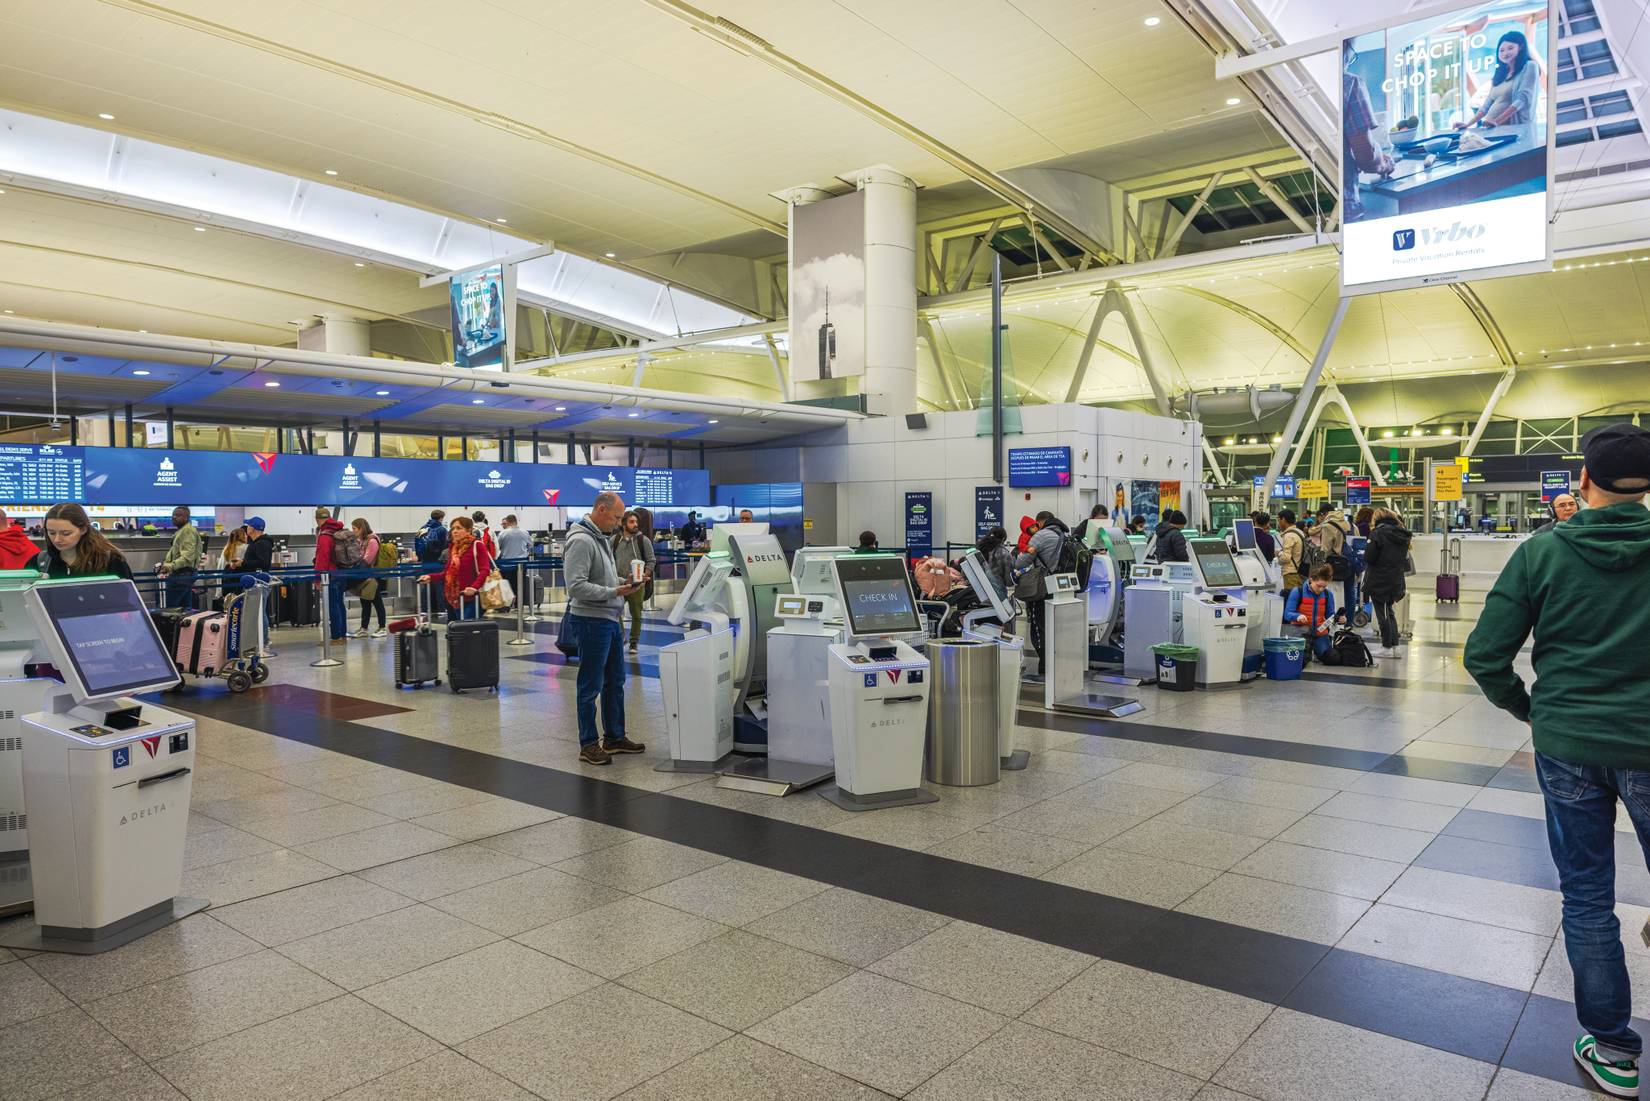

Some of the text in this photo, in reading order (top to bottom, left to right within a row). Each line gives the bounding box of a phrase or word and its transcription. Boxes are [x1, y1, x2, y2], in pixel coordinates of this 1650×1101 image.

[1394, 34, 1487, 68] SPACE TO
[1382, 55, 1500, 92] CHOP IT UP.
[1421, 221, 1486, 245] Vrbo
[1420, 252, 1454, 262] Vacation
[1455, 248, 1484, 256] Rentals
[860, 592, 898, 603] CHECK IN
[132, 802, 166, 820] DELTA
